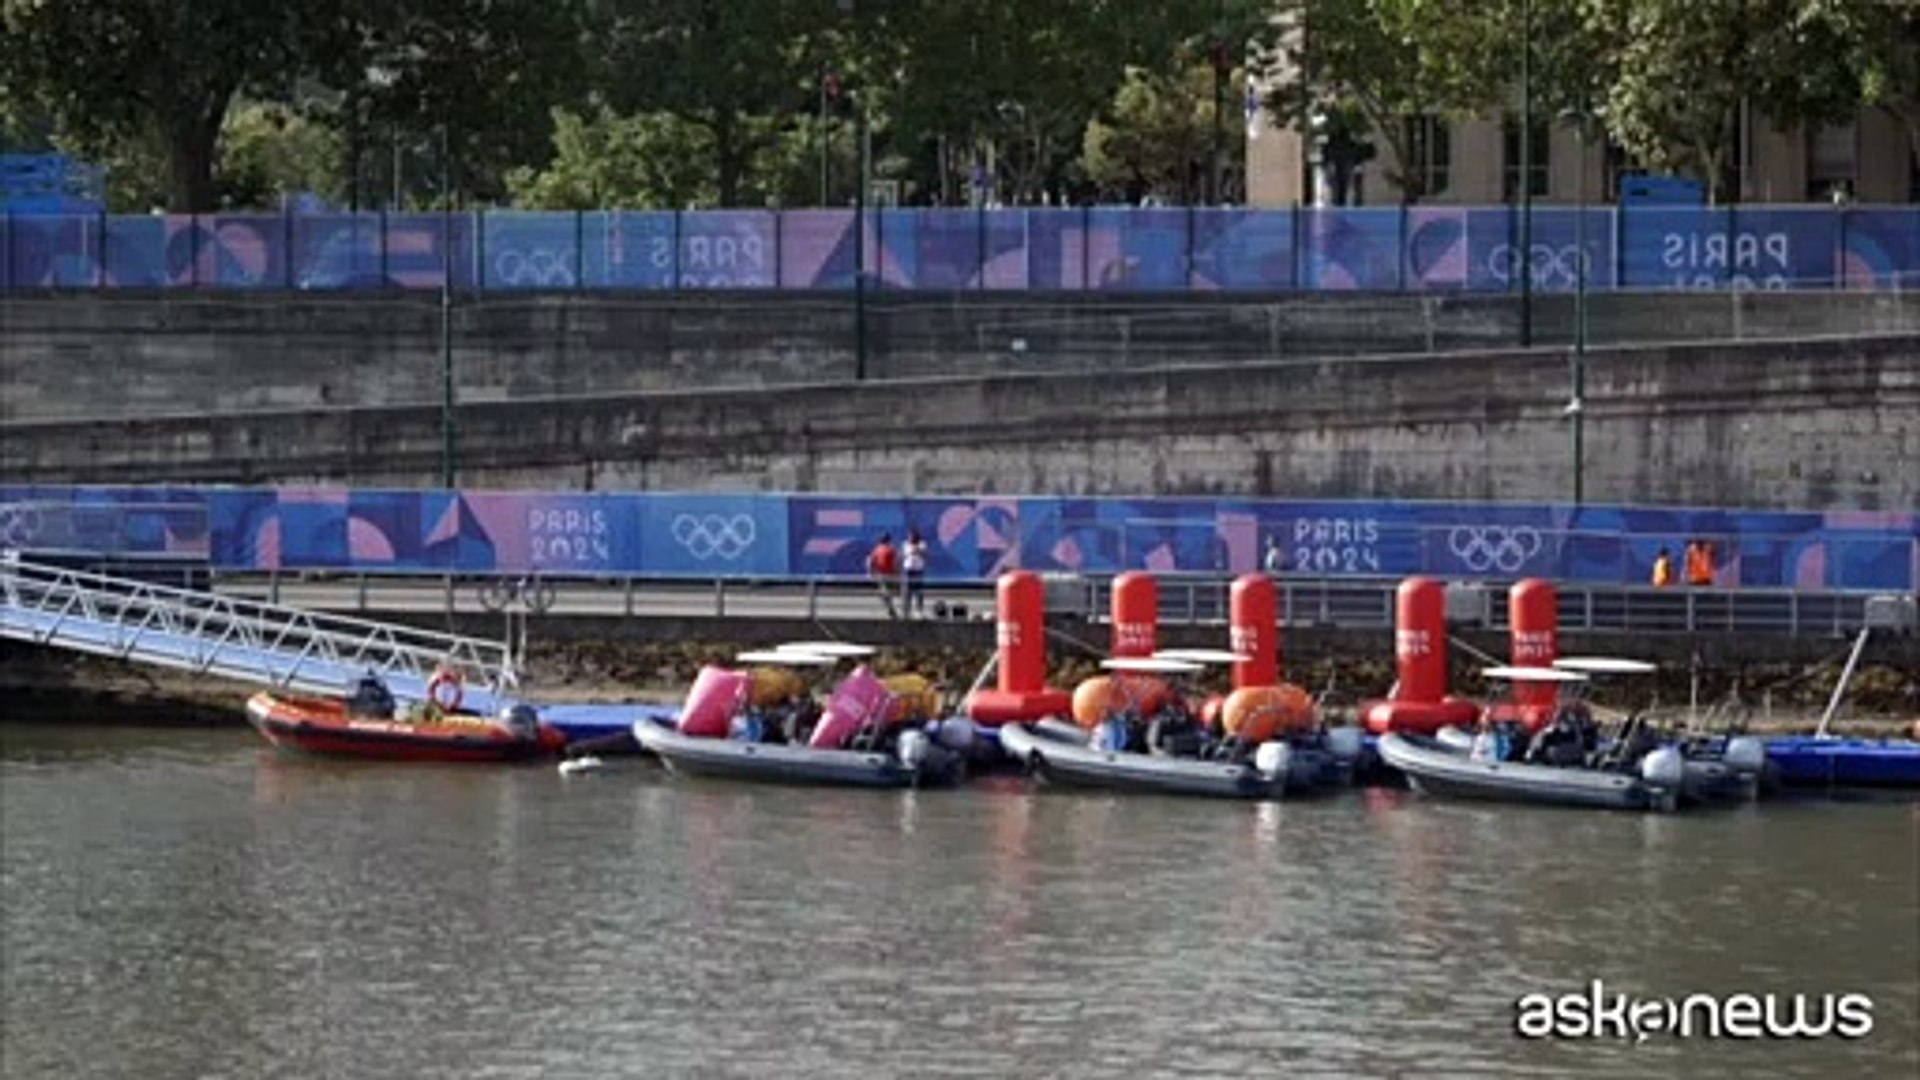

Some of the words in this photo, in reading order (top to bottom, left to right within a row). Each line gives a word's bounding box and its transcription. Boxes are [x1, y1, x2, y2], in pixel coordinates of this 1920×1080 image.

[529, 509, 606, 534] PARIS
[1294, 518, 1379, 543] PARIS
[530, 536, 609, 561] 2024
[1295, 546, 1379, 572] 2024
